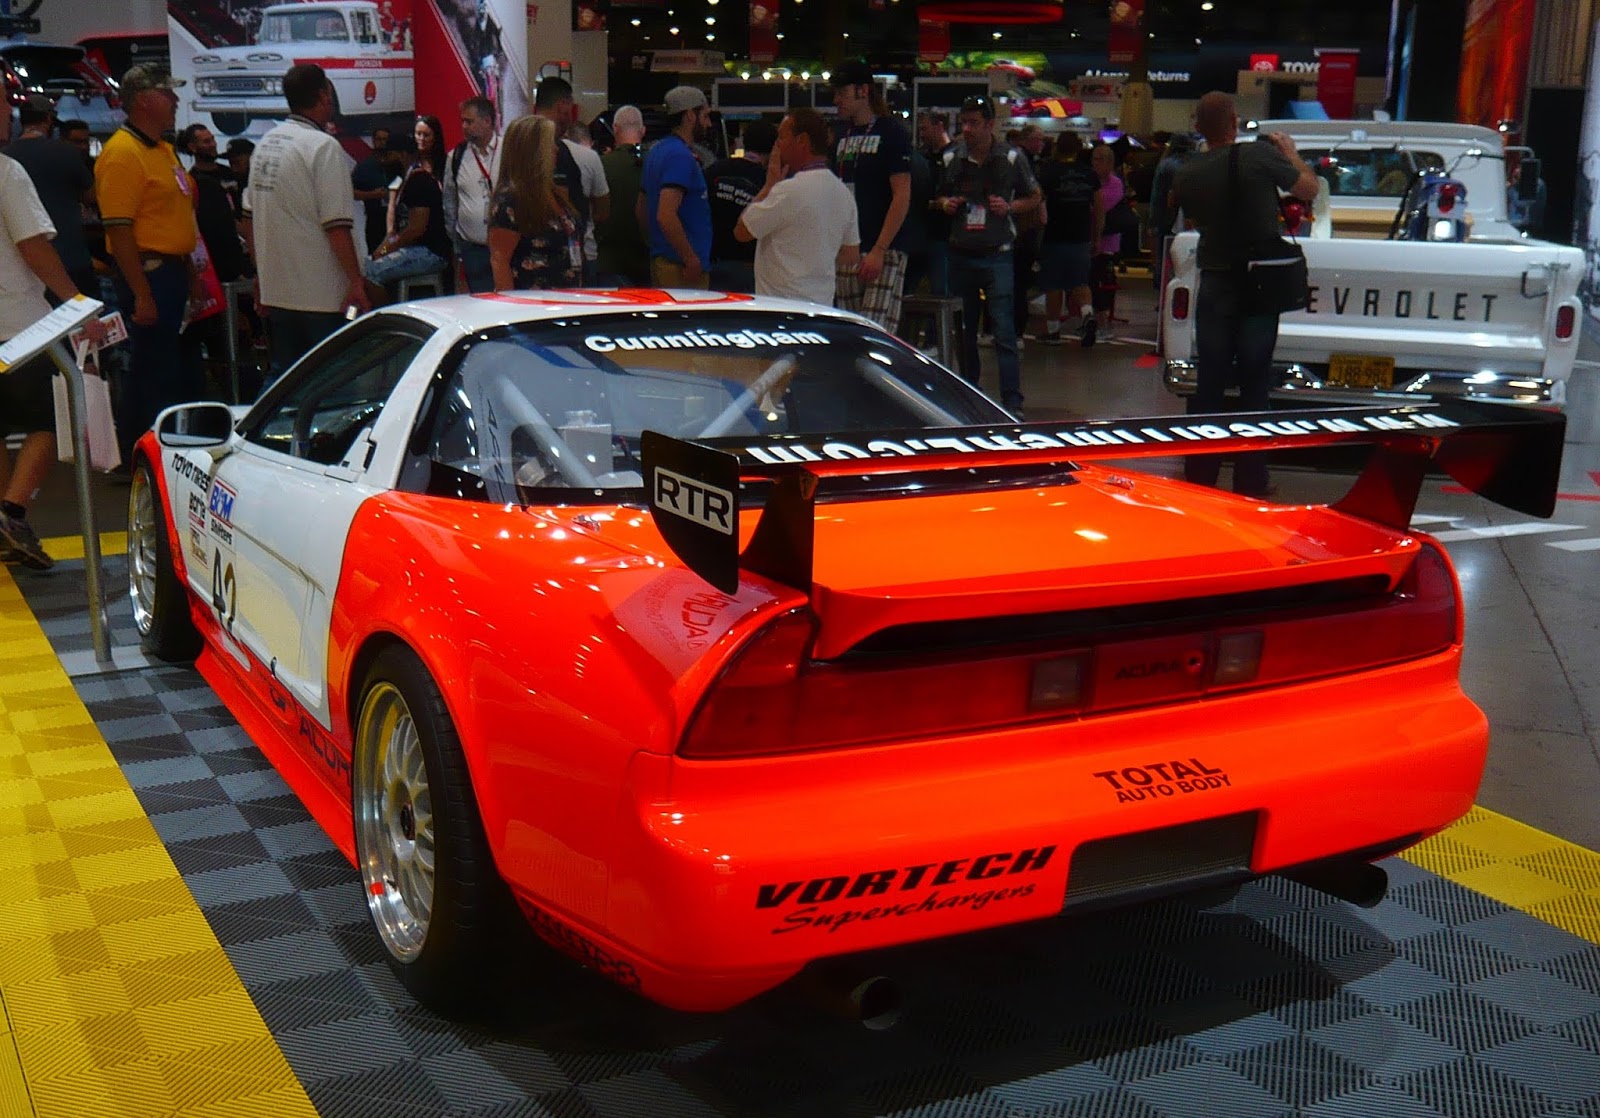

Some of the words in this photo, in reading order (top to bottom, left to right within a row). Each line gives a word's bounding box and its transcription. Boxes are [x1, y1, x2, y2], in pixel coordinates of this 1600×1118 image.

[1304, 286, 1498, 322] EVROLET
[584, 329, 830, 352] Cunningham
[172, 453, 191, 479] TOYO
[191, 468, 212, 494] TIRES
[657, 472, 730, 529] RTR
[213, 547, 237, 633] 42
[1092, 758, 1223, 790] TOTAL
[1115, 784, 1174, 804] AUTO
[1175, 773, 1232, 794] BODY
[756, 845, 1057, 909] VORTECH
[771, 882, 1037, 935] Superchargers
